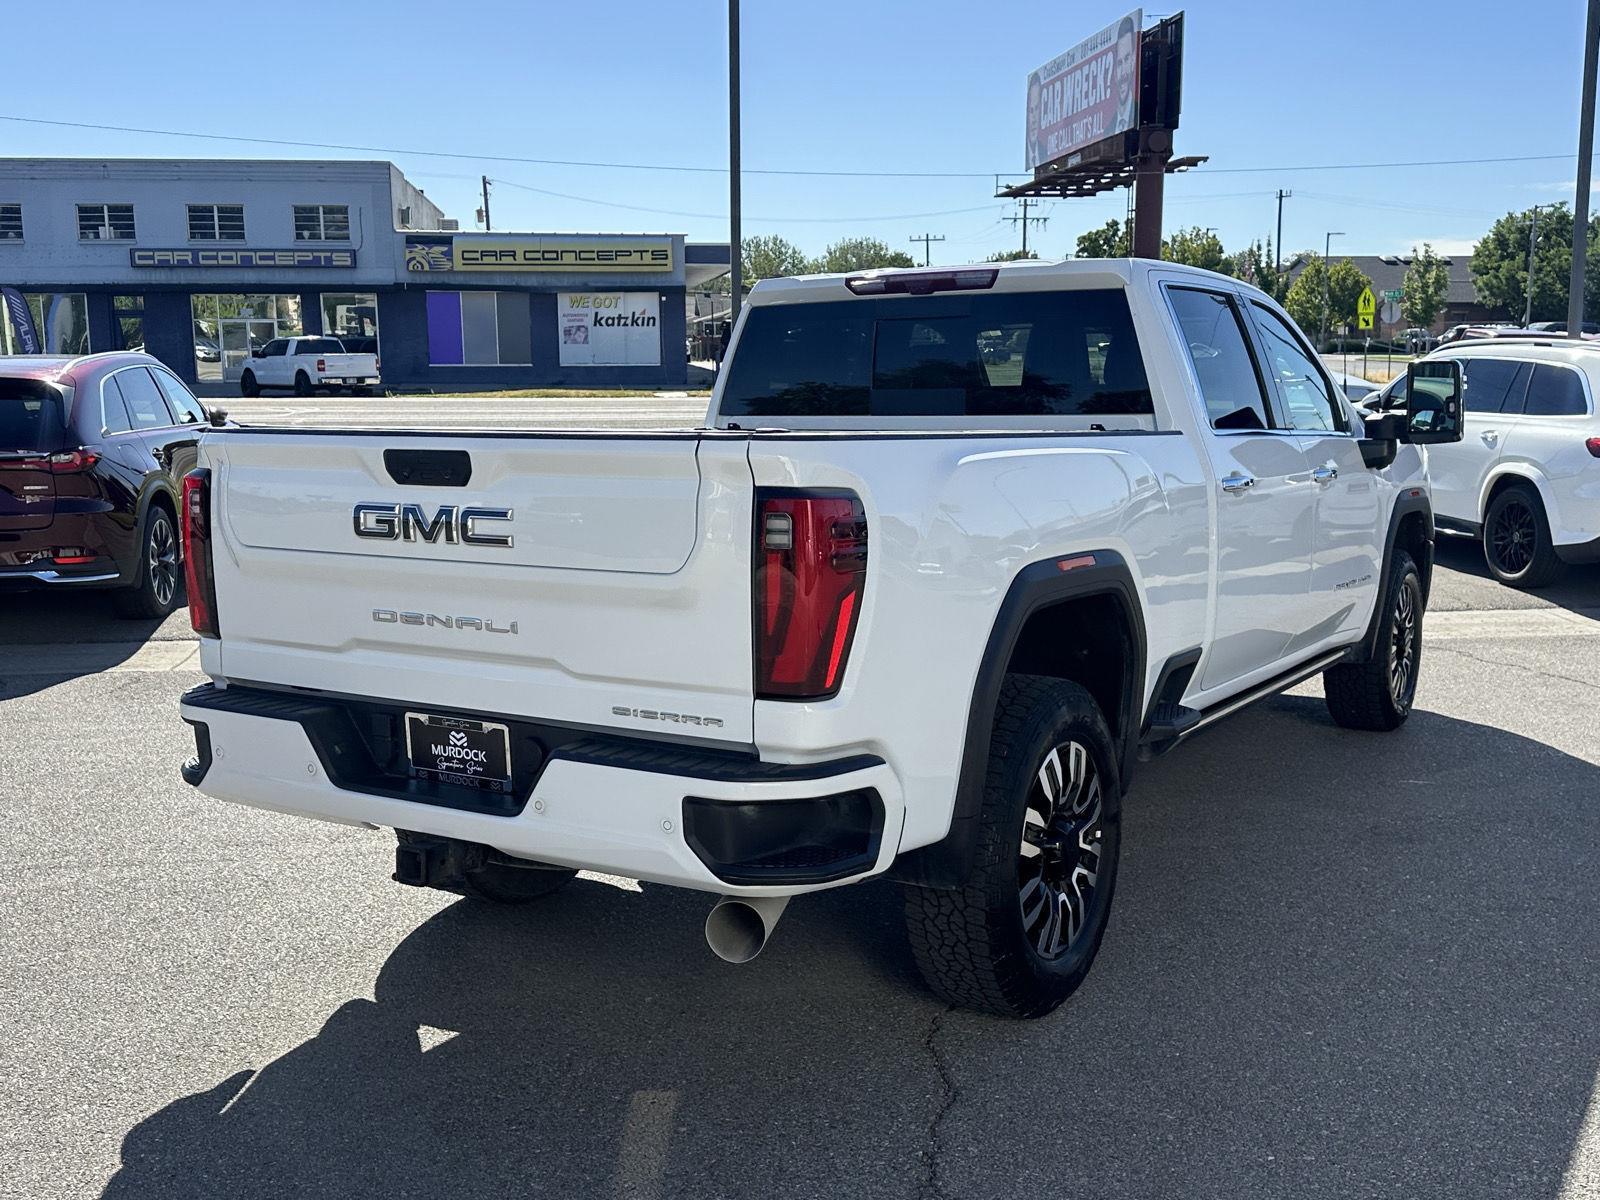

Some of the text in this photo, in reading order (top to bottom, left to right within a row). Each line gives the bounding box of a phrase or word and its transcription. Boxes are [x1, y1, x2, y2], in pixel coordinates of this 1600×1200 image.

[1041, 51, 1114, 130] CAR WRECK?
[1059, 125, 1072, 150] CALL
[1092, 111, 1104, 138] ALL
[134, 251, 352, 266] CAR CONCEPTS
[461, 249, 669, 262] CAR CONCEPTS
[569, 296, 620, 309] WE GOT
[593, 311, 656, 328] katzkin
[353, 501, 515, 548] GMC
[372, 609, 519, 635] DENALI
[611, 706, 724, 727] SIERRA
[431, 744, 488, 763] MURDOCK
[438, 773, 481, 787] MURDOCK
